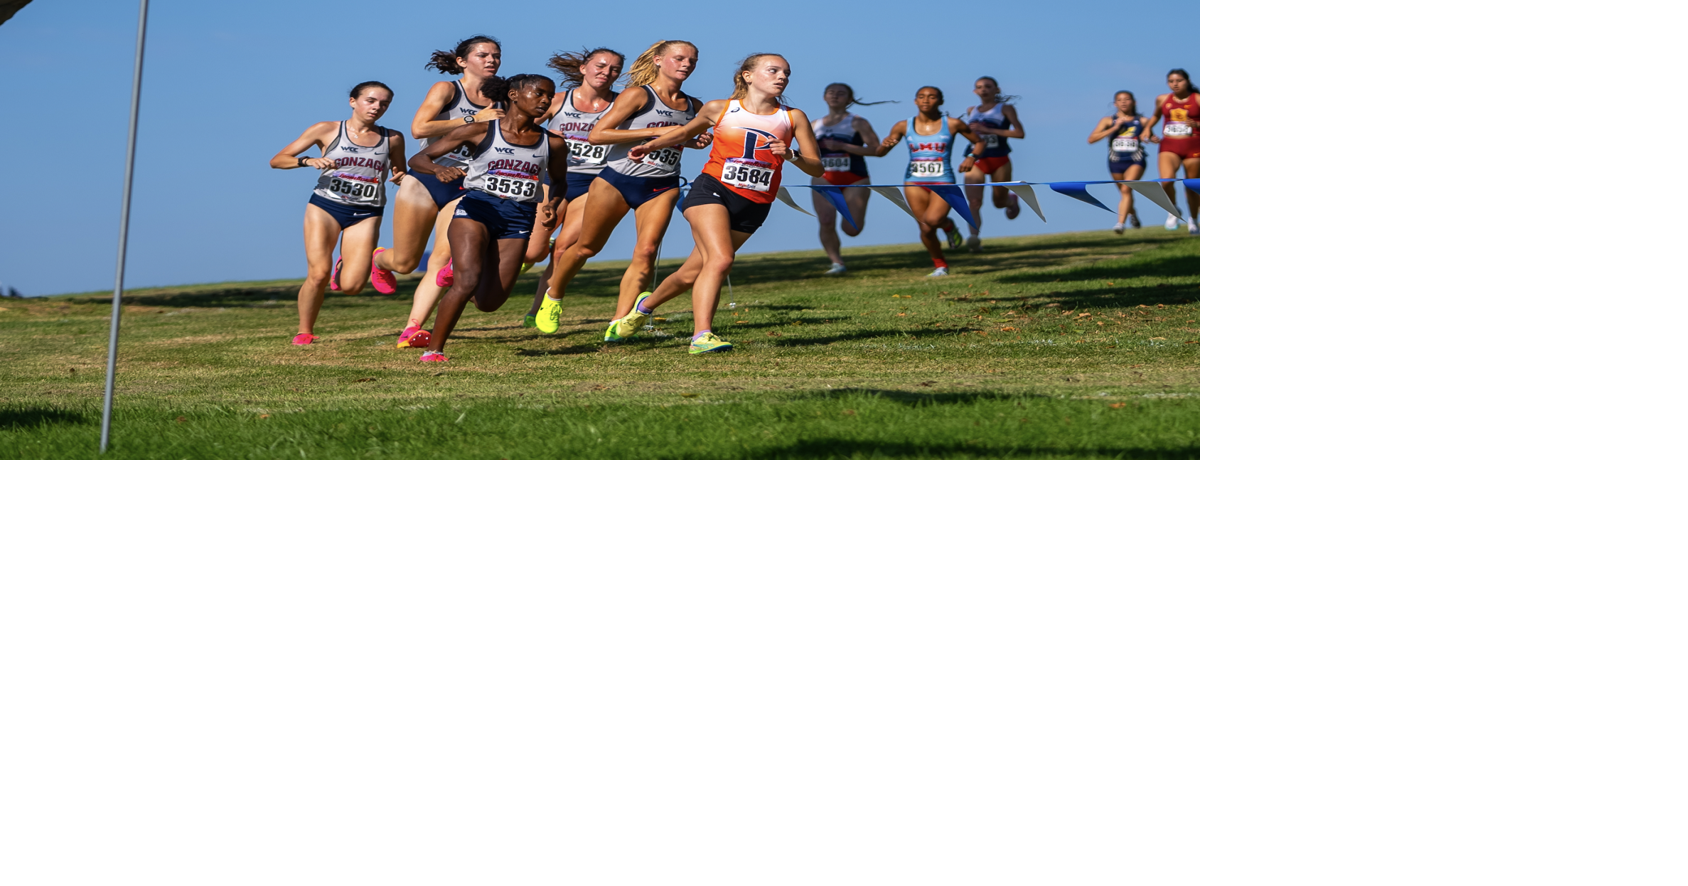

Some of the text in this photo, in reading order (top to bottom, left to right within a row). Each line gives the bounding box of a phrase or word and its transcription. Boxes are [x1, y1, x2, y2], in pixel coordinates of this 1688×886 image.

[460, 107, 478, 115] WCC
[564, 111, 581, 119] WCC
[656, 109, 674, 117] WCC
[340, 145, 359, 153] WCC
[494, 147, 515, 155] WCC
[909, 142, 947, 153] LMU
[911, 162, 942, 173] 3567
[724, 165, 772, 187] 3584
[330, 179, 375, 198] 3530
[487, 176, 536, 197] 3533
